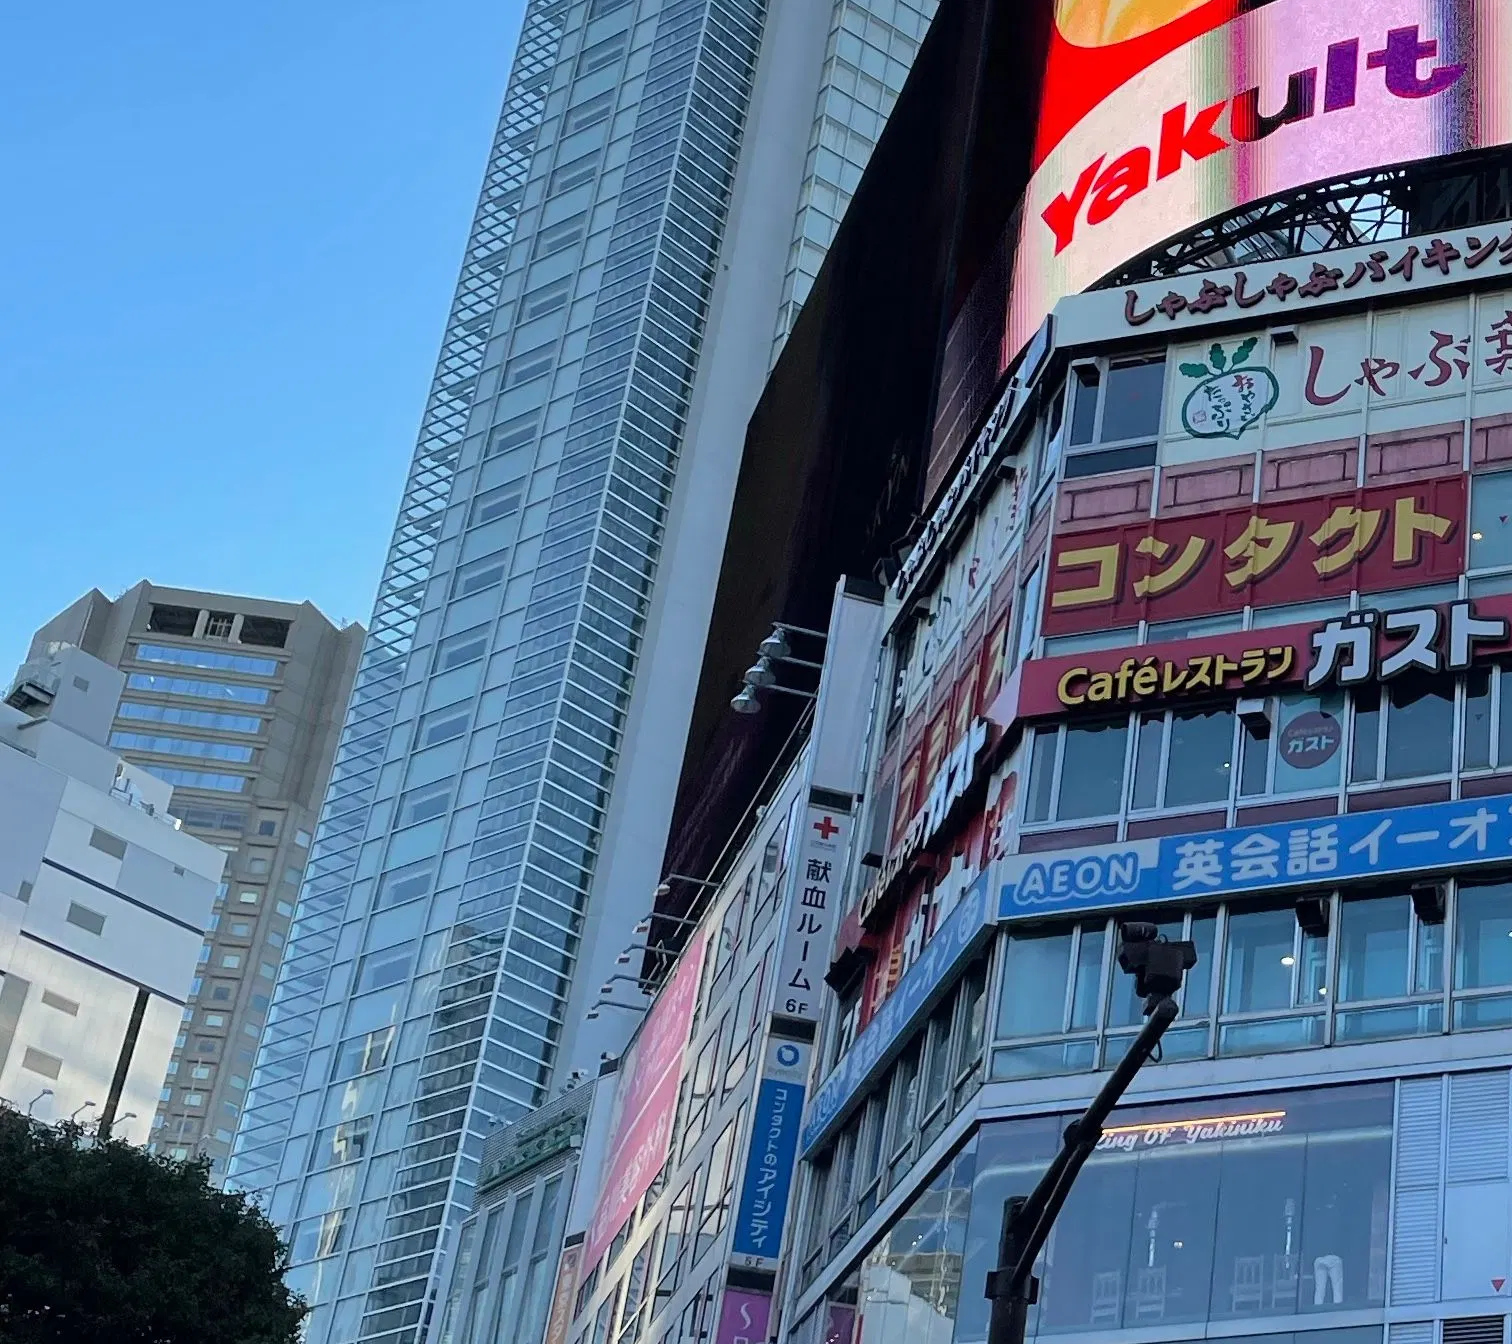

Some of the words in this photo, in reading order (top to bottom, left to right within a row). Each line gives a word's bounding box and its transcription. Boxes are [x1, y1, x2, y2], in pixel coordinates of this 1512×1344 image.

[1040, 23, 1468, 258] Yakult
[1053, 498, 1459, 608] コンタクト
[1304, 602, 1508, 691] ガスト
[1287, 736, 1334, 754] ガスト
[1014, 853, 1140, 905] AEON
[788, 858, 832, 992] 献血ルーム
[785, 998, 808, 1014] 6F
[1184, 1118, 1284, 1144] Yakiniku
